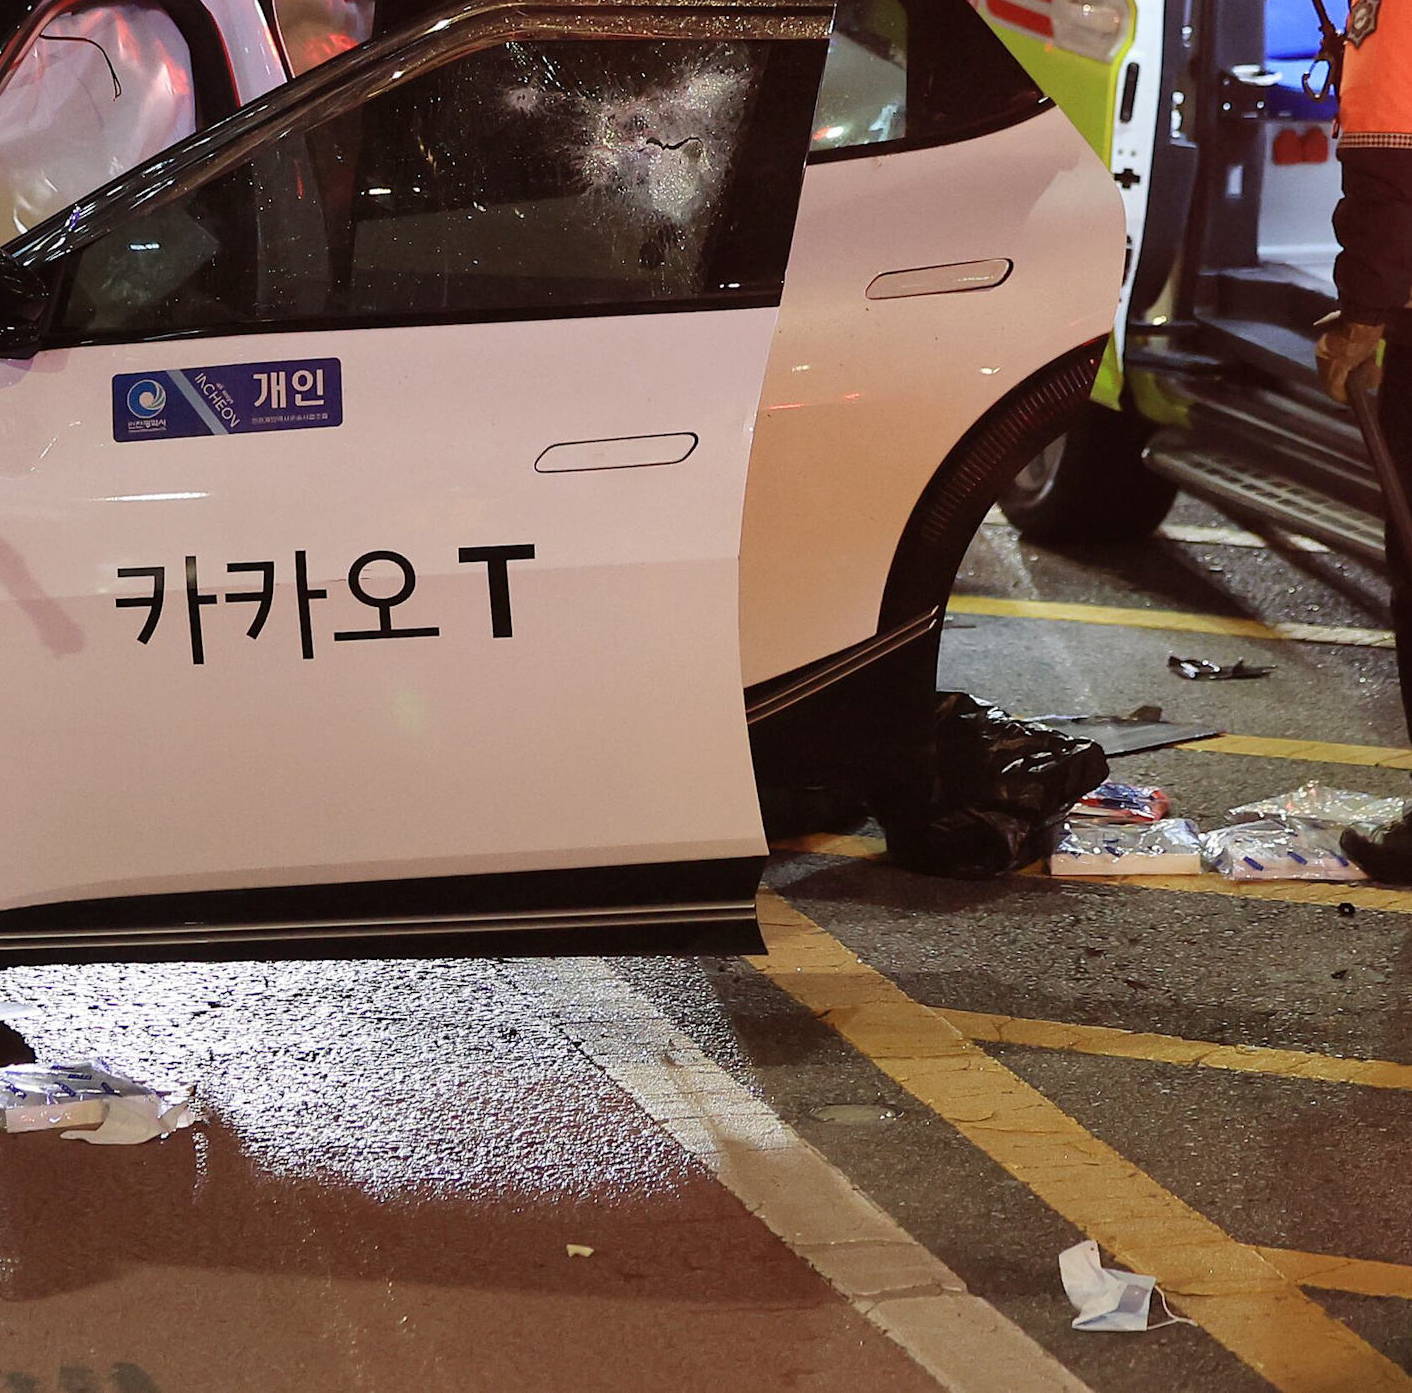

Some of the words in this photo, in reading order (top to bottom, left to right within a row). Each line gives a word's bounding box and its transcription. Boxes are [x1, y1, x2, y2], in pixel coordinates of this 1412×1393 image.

[252, 368, 325, 410] 개인
[115, 550, 441, 666] 카카오
[457, 543, 536, 640] T
